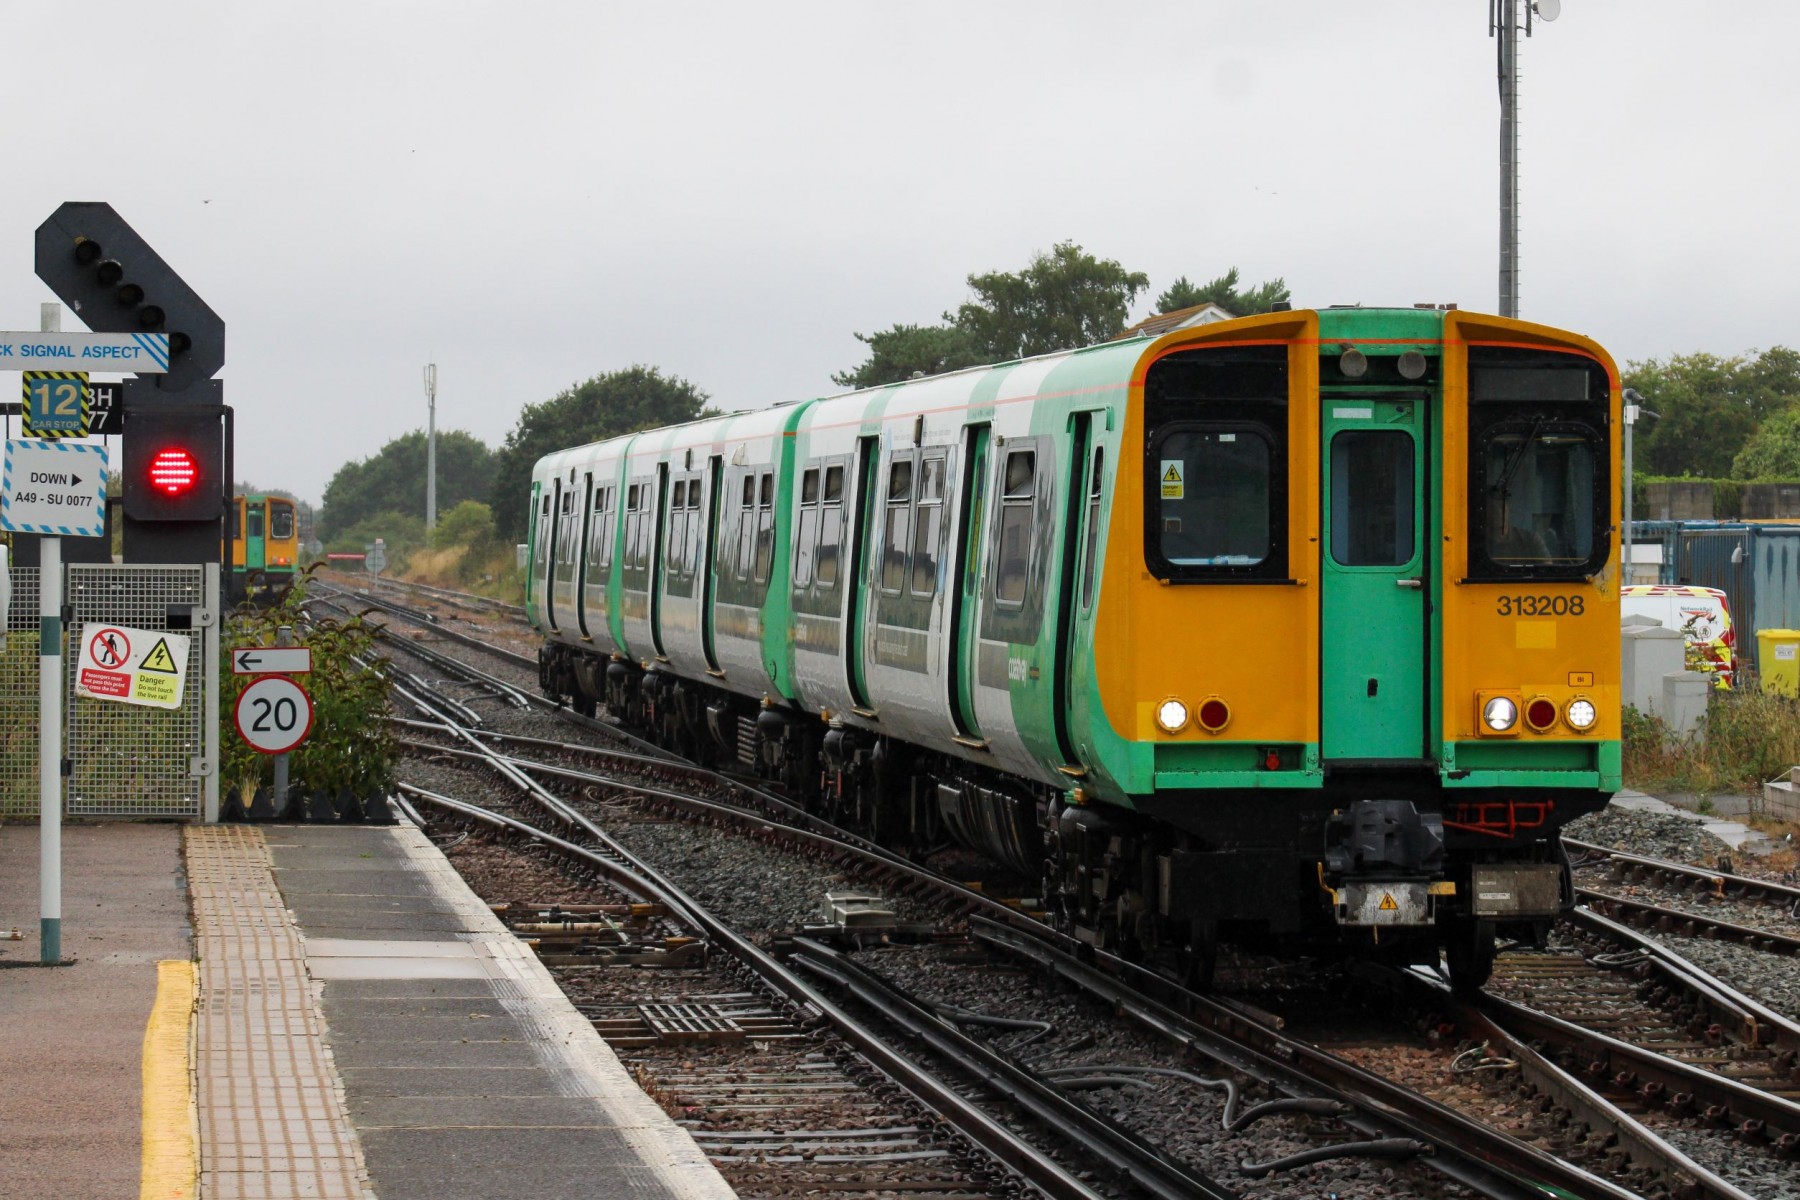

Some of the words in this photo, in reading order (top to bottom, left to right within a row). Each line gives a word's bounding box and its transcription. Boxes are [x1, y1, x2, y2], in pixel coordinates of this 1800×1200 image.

[20, 344, 75, 358] SIGNAL
[81, 345, 141, 359] ASPECT
[34, 383, 78, 415] 12
[31, 420, 52, 429] CAR
[53, 420, 80, 429] STOP
[30, 472, 67, 485] DOWN
[15, 492, 37, 504] A49
[47, 493, 63, 505] SU
[66, 495, 92, 507] 0077
[1496, 595, 1585, 616] 313208
[85, 672, 111, 680] Passengers
[139, 675, 166, 686] Danger
[251, 697, 297, 732] 20
